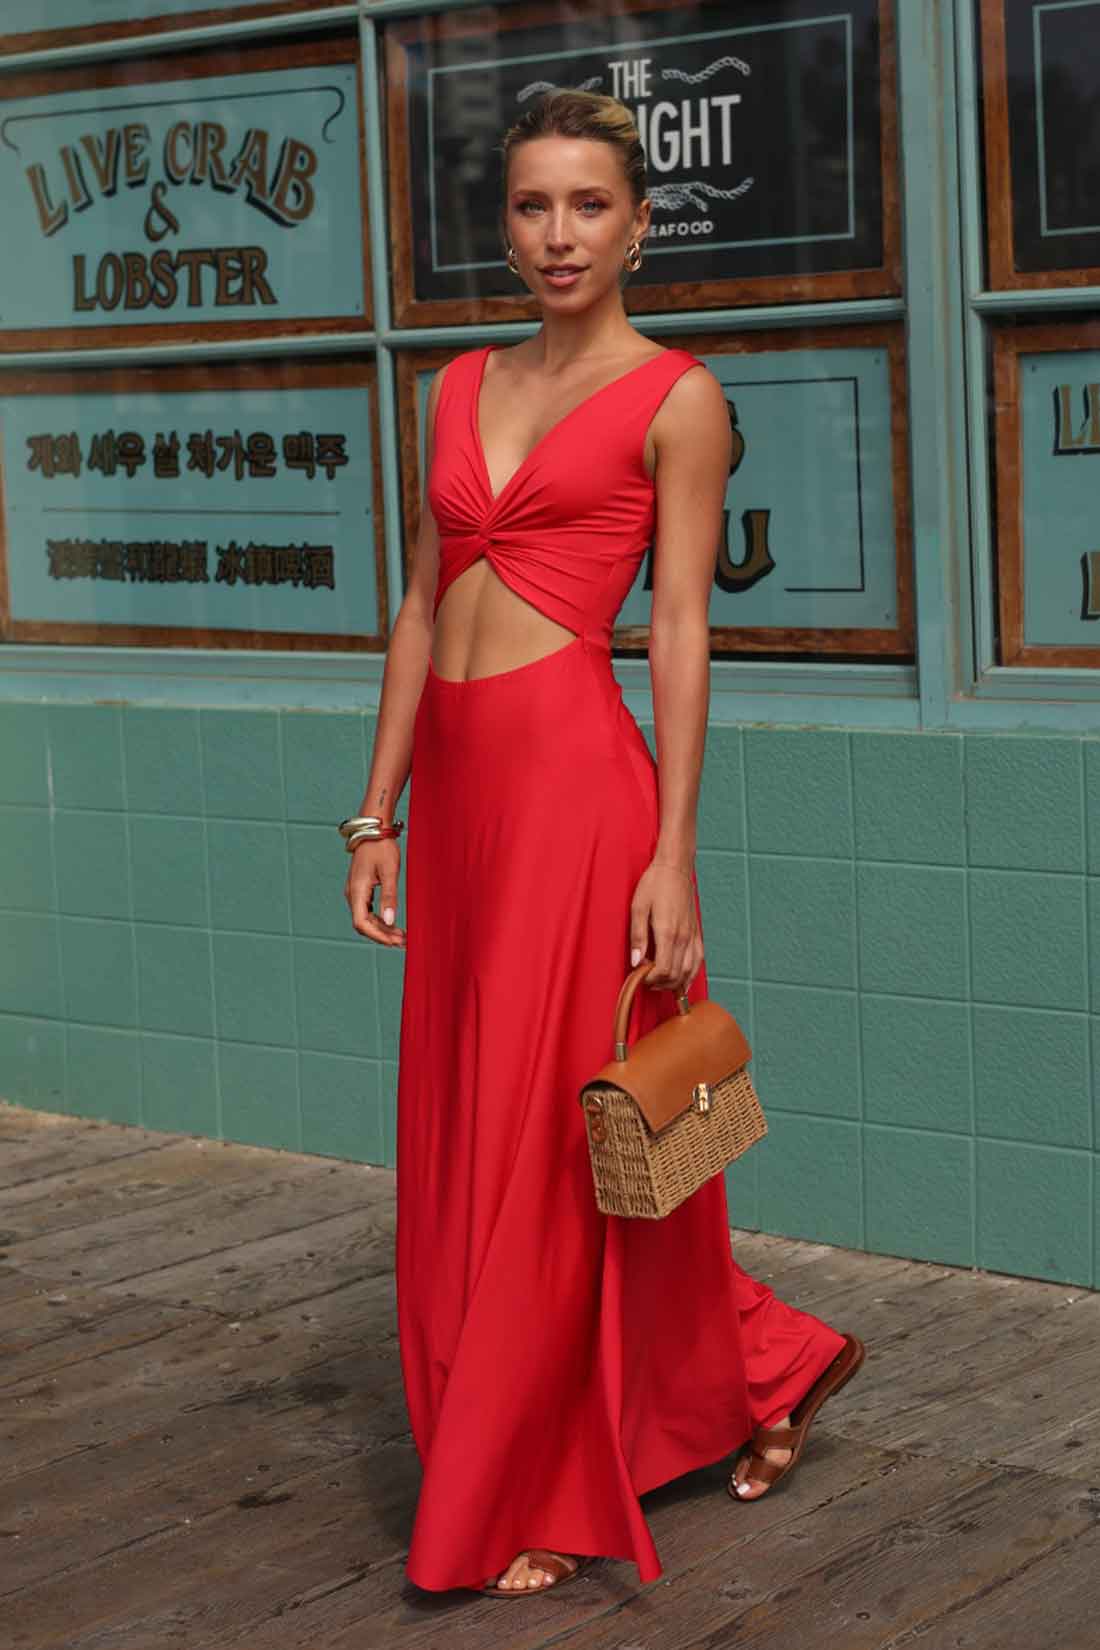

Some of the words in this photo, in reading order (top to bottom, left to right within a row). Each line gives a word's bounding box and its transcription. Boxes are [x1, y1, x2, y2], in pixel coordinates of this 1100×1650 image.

[608, 59, 652, 99] THE
[637, 95, 742, 172] IGHT
[26, 123, 152, 237] LIVE
[163, 121, 318, 228] CRAB
[144, 181, 181, 242] &
[649, 220, 714, 238] EAFOOD
[73, 246, 279, 312] LOBSTER
[282, 432, 349, 480] 맥주
